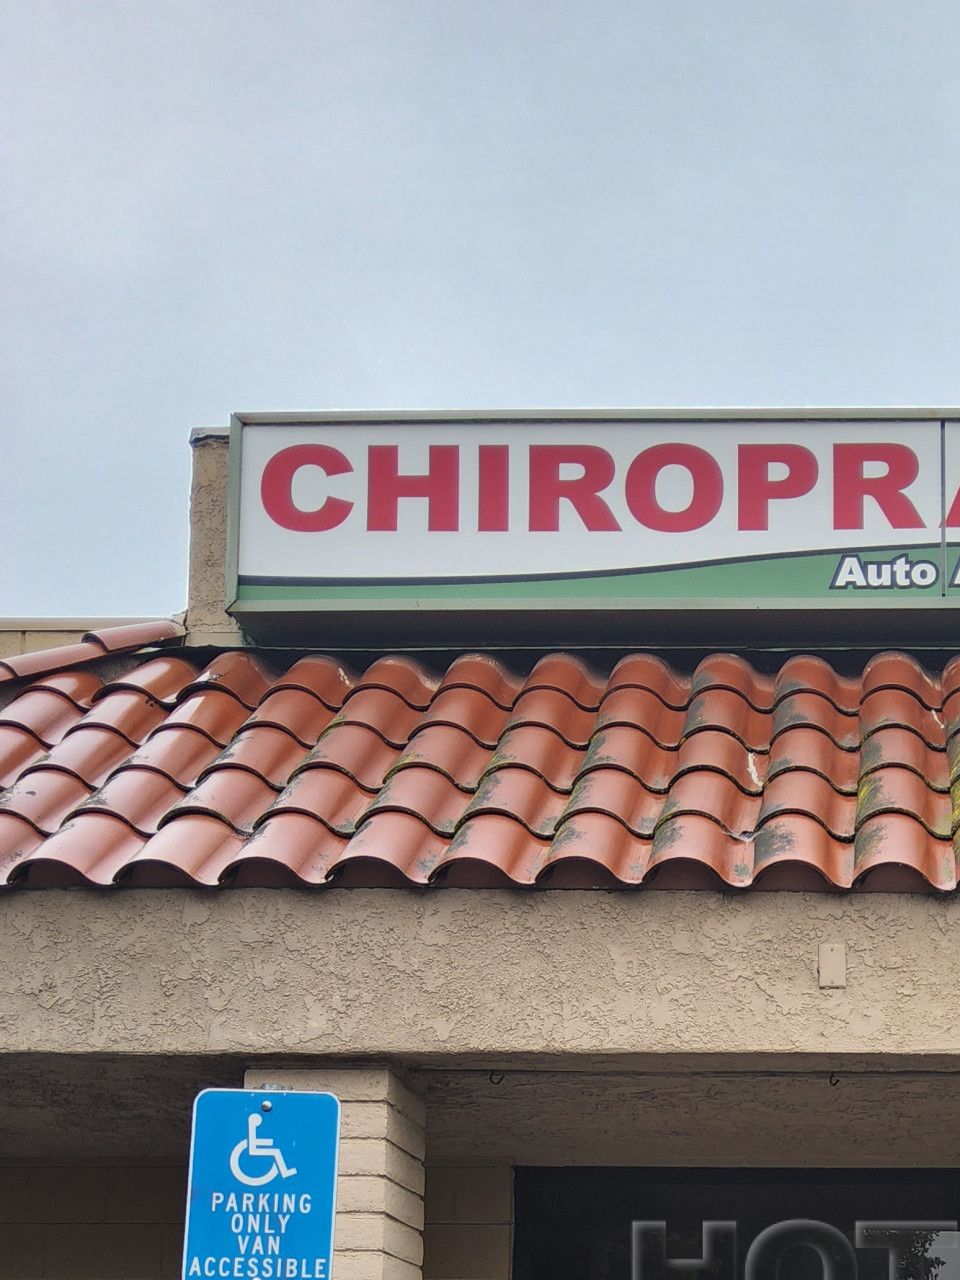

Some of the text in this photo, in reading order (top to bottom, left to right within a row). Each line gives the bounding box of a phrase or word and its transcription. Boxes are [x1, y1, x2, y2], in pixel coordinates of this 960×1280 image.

[831, 552, 940, 588] Auto
[211, 1192, 313, 1214] PARKING
[231, 1213, 290, 1234] ONLY
[237, 1235, 280, 1255] VAN
[189, 1257, 327, 1279] ACCESSIBLE
